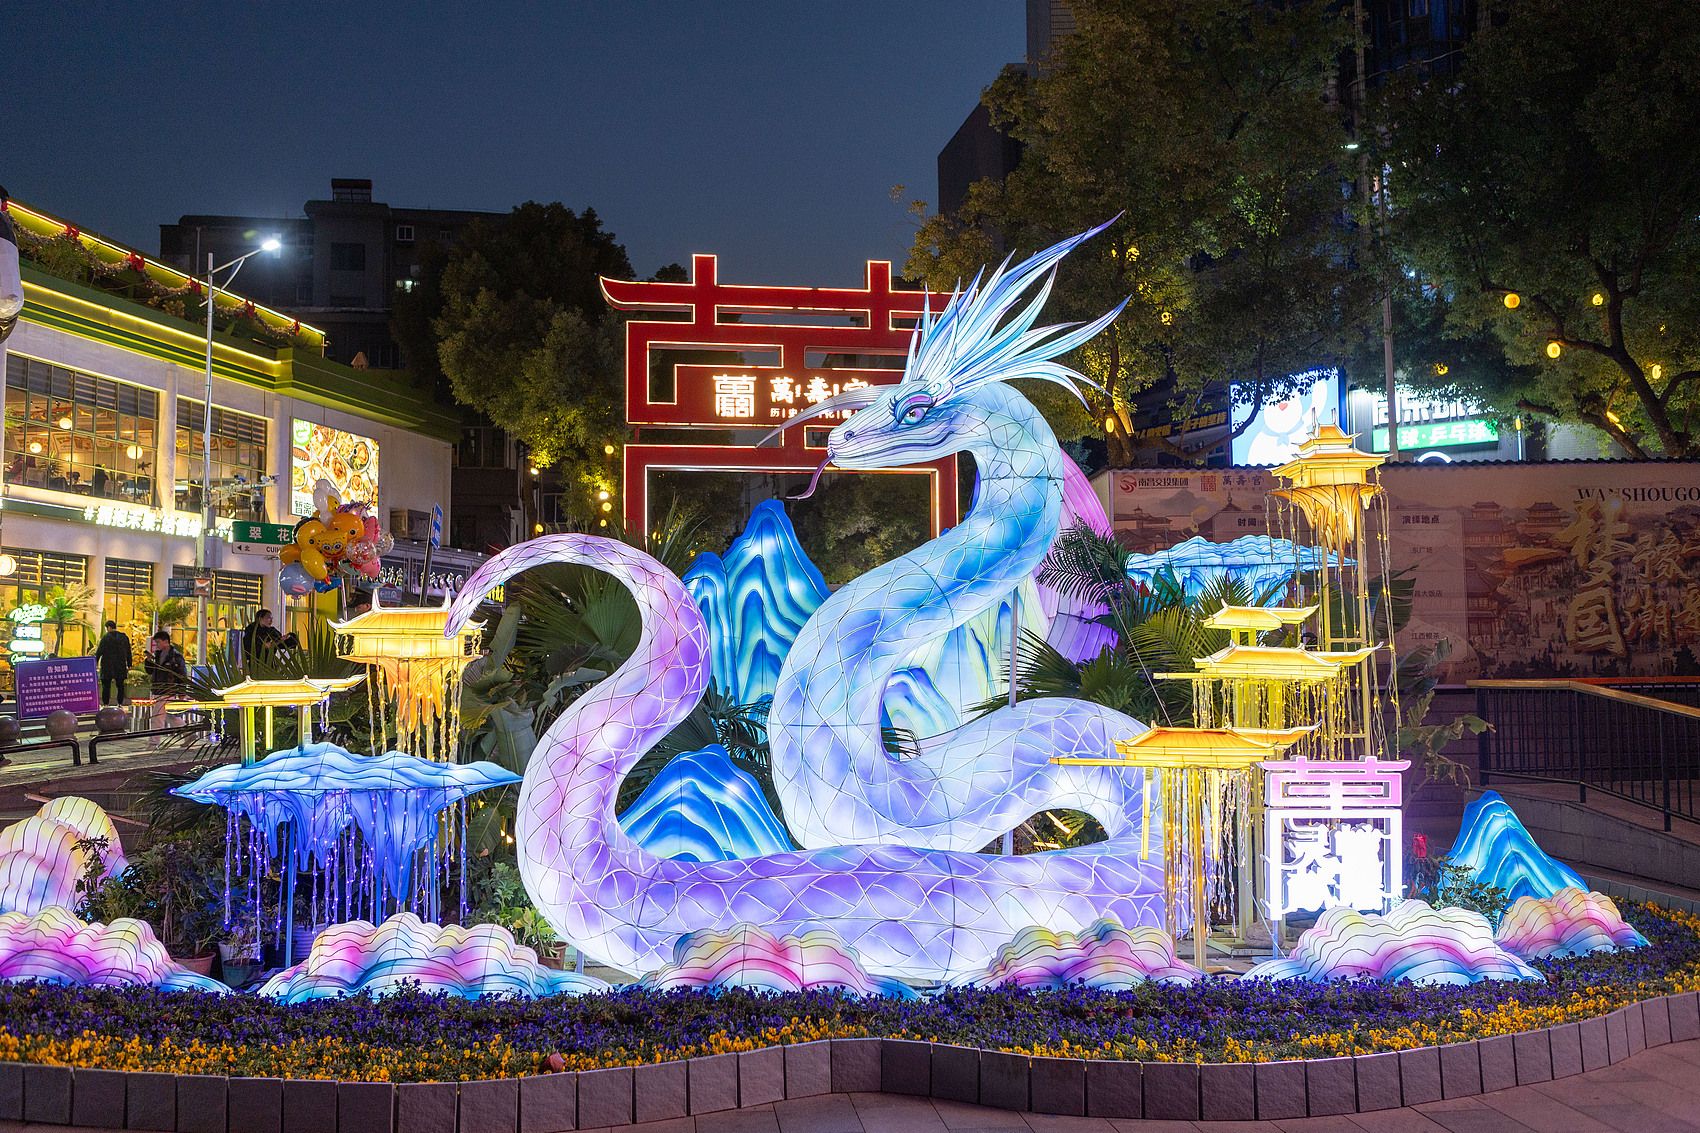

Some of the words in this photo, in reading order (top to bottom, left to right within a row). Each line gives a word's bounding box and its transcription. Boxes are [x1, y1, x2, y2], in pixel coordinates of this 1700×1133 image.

[1237, 518, 1257, 527] 时间
[1402, 515, 1440, 525] 演绎地点
[248, 526, 290, 542] 翠花
